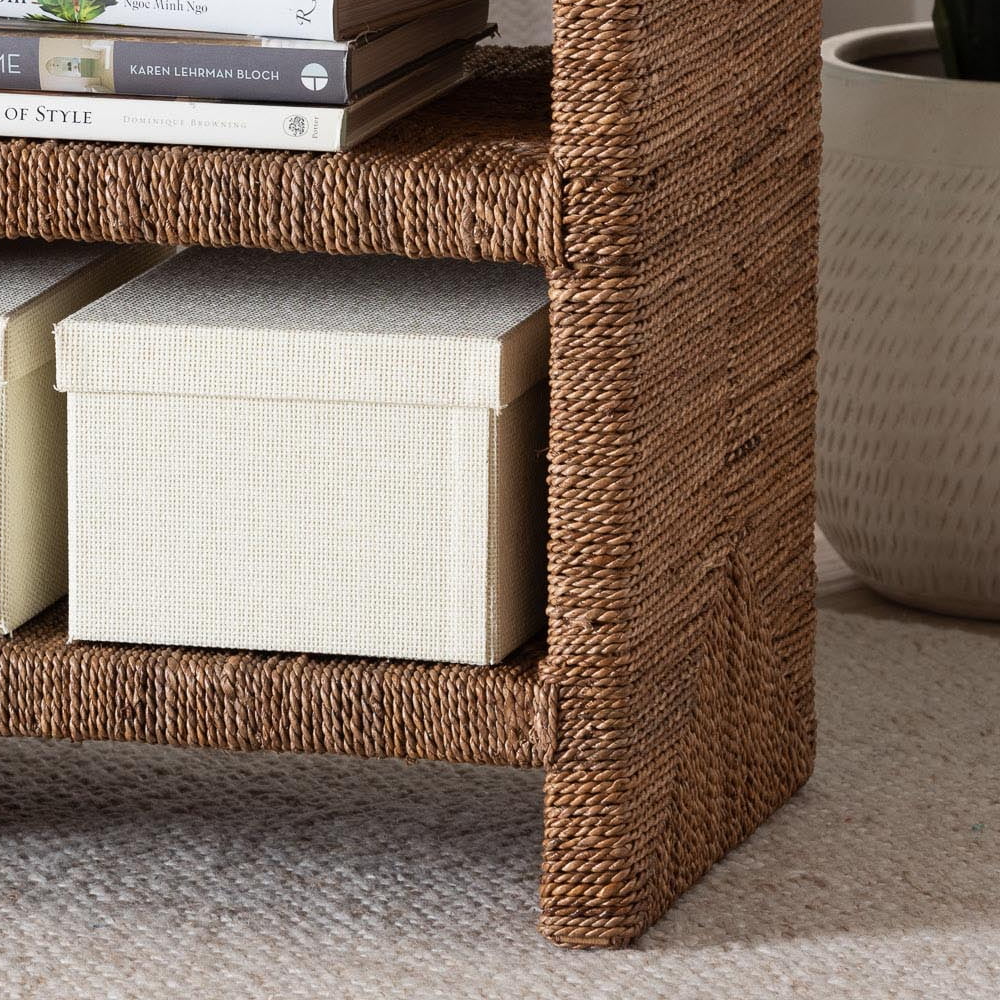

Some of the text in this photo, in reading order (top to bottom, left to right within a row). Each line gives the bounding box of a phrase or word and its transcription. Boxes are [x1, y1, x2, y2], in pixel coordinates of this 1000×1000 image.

[186, 0, 208, 15] Ngo
[129, 64, 280, 82] KAREN LEHRMAN BLOCH
[35, 105, 93, 125] STYLE
[122, 115, 185, 128] DOMINIQUE
